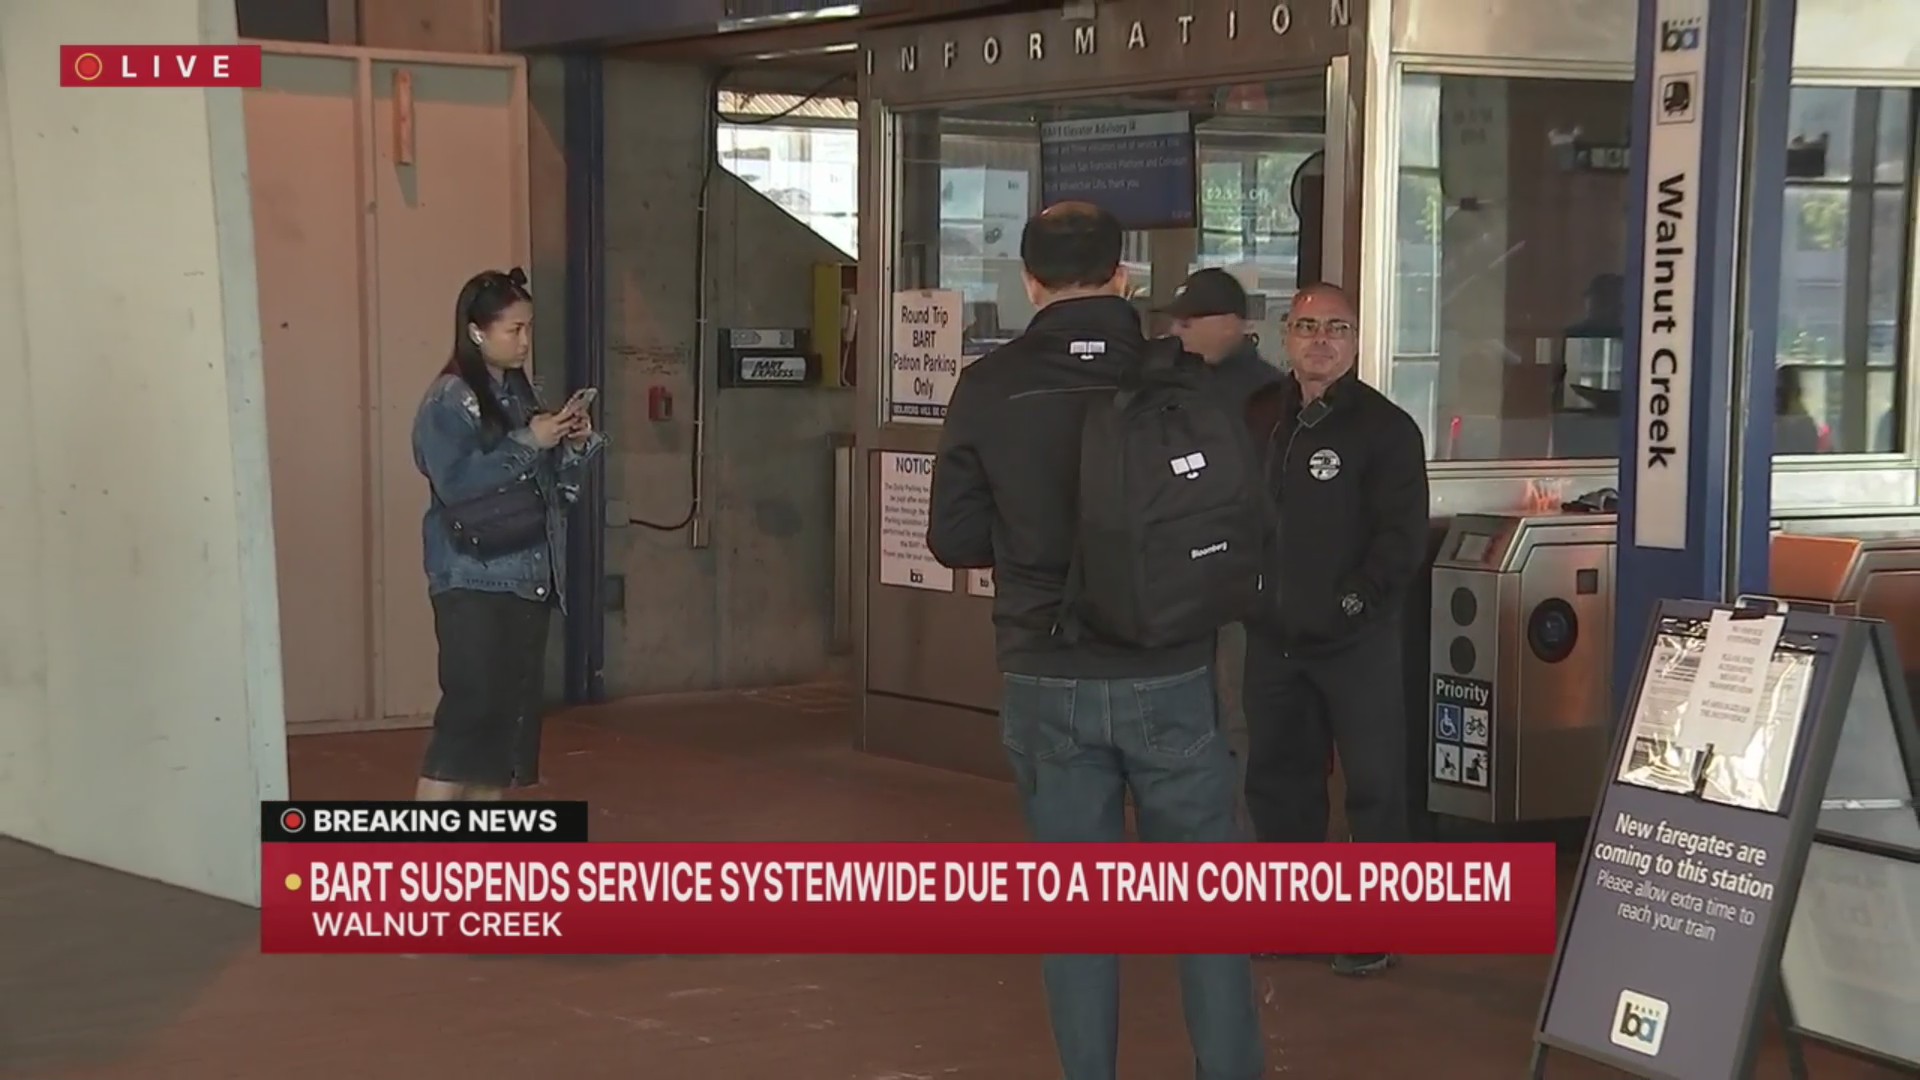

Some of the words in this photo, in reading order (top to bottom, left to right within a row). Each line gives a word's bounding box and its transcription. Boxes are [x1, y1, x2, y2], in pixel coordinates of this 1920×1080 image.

[866, 0, 1350, 74] INFORMATION
[1094, 120, 1127, 135] Advisory
[1652, 172, 1686, 334] Walnut
[901, 305, 929, 323] Round
[932, 306, 948, 328] Trip
[912, 330, 936, 348] BART
[893, 352, 920, 372] Patron
[923, 353, 957, 377] Parking
[914, 377, 934, 399] Only
[1647, 347, 1678, 468] Creek
[1435, 678, 1489, 706] Priority
[1615, 812, 1653, 840] New
[1655, 821, 1734, 859] faregates
[1736, 843, 1768, 866] are
[1594, 841, 1652, 876] coming
[1655, 853, 1673, 876] to
[1676, 857, 1708, 885] this
[1710, 868, 1775, 901] station
[1596, 868, 1633, 896] Please
[1634, 879, 1670, 903] allow
[1670, 888, 1703, 912] extra
[1706, 896, 1736, 922] time
[1738, 903, 1756, 926] to
[1617, 900, 1651, 923] reach
[1651, 912, 1683, 932] your
[1684, 918, 1716, 941] train
